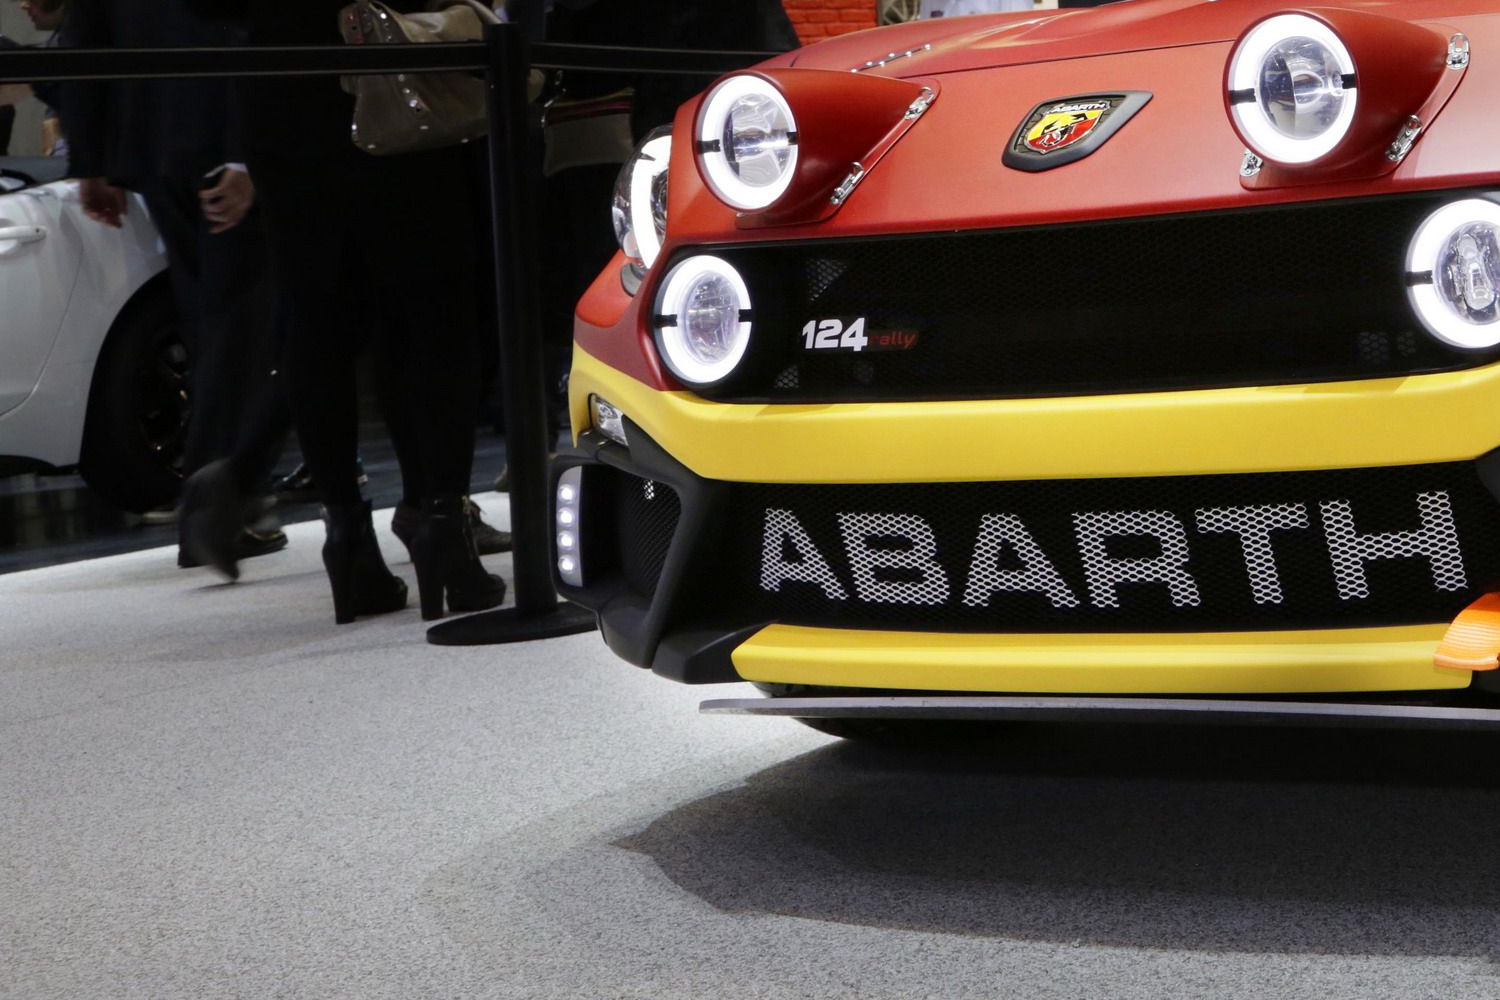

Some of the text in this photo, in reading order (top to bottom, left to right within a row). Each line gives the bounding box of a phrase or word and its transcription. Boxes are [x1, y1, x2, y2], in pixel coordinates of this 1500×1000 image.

[1051, 102, 1106, 113] ABARTH
[802, 317, 869, 352] 124
[758, 489, 1469, 608] ABARTH
